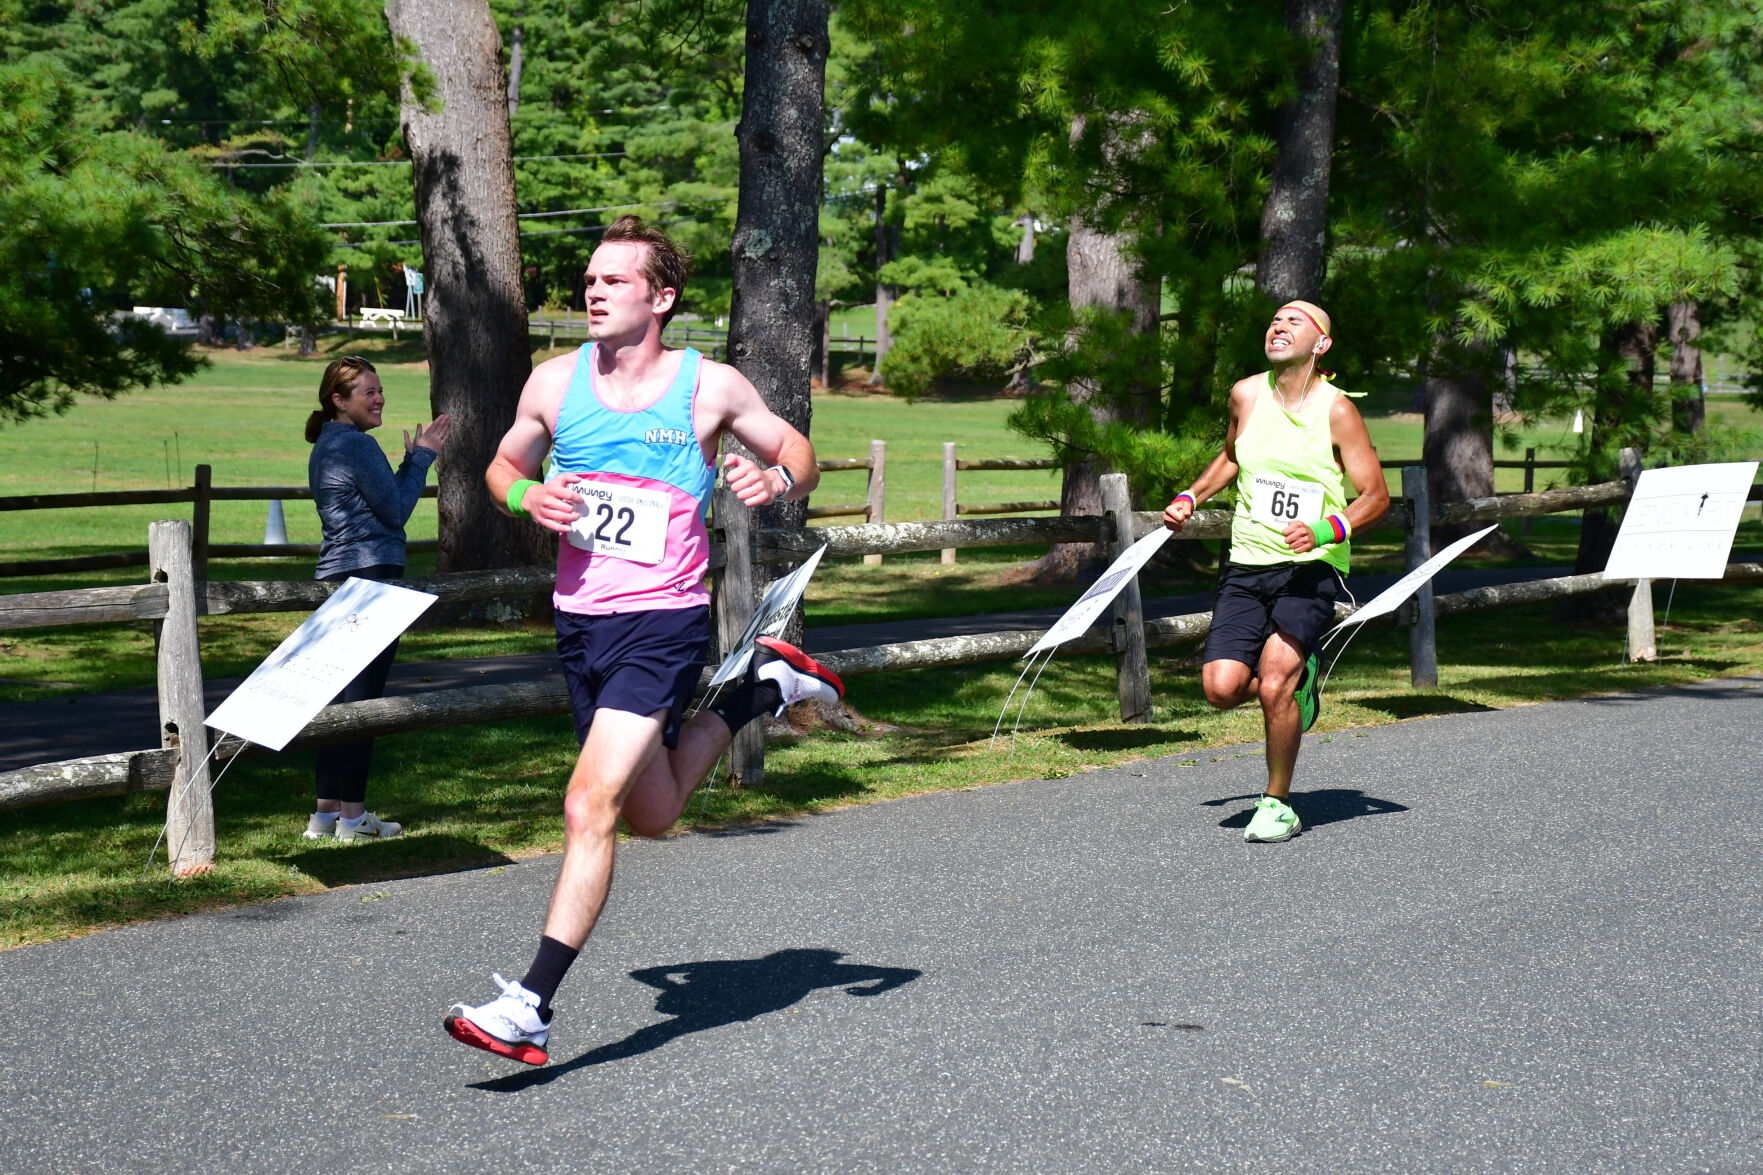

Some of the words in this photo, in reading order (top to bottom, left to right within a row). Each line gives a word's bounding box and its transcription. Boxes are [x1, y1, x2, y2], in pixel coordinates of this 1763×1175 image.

[644, 428, 687, 446] NMH
[1271, 490, 1300, 520] 65
[594, 503, 635, 547] 22
